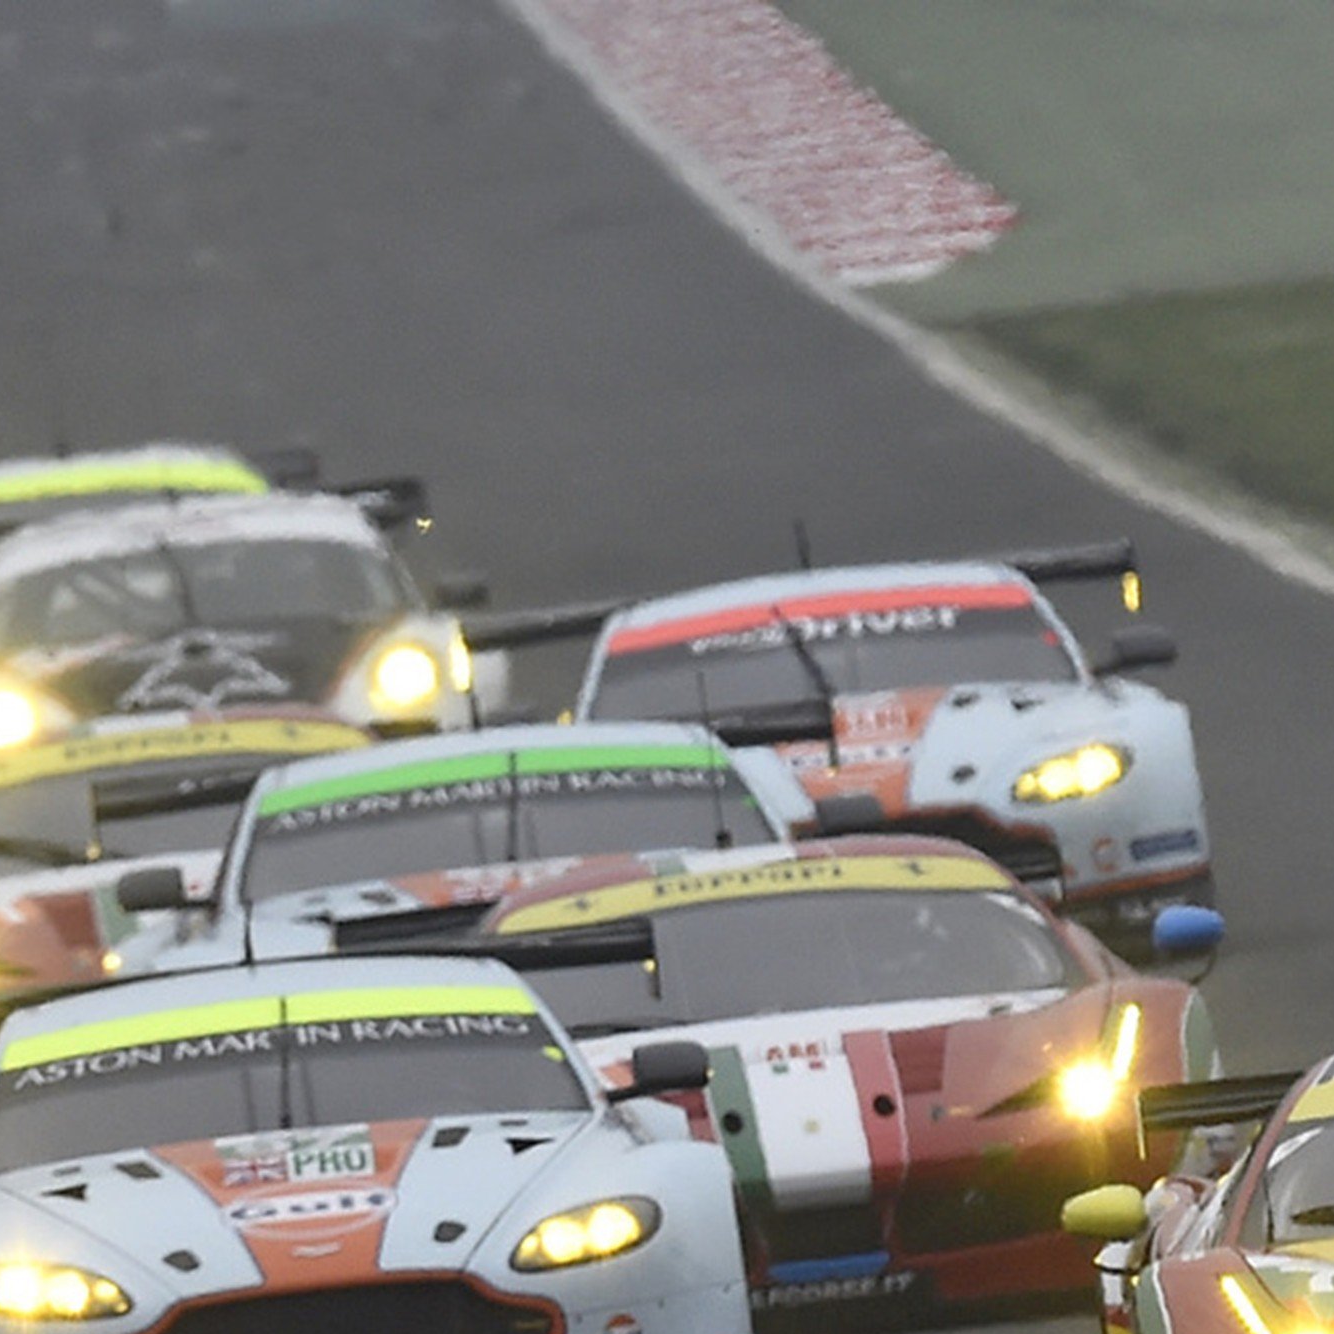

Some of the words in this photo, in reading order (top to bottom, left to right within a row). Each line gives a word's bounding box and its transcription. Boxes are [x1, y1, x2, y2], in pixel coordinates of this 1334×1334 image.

[14, 1046, 163, 1090] ASTON
[173, 1022, 342, 1062] MARIN
[351, 1014, 531, 1041] RACING
